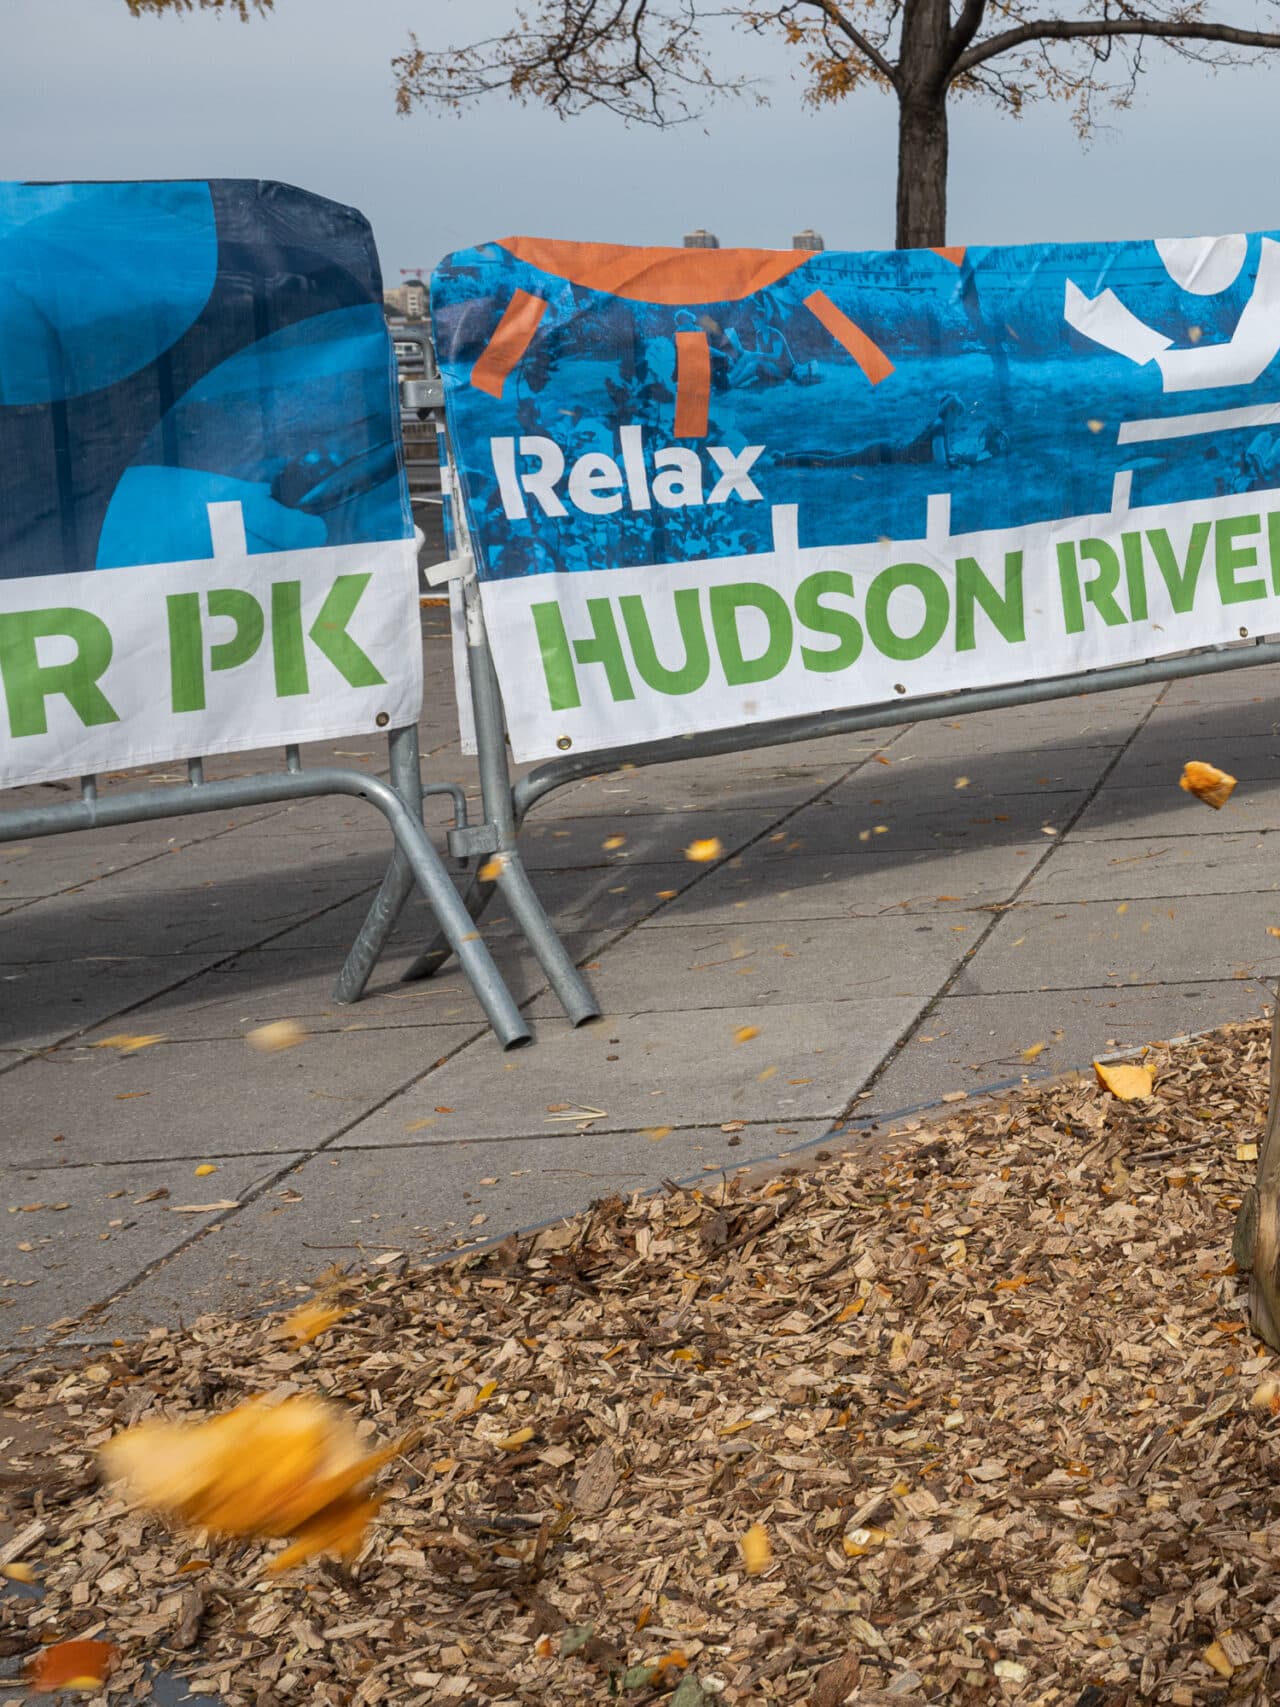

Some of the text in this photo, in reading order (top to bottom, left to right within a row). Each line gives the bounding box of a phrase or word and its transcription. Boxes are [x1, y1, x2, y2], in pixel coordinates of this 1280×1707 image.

[490, 425, 764, 519] Relax
[166, 573, 387, 713] PK
[530, 551, 1026, 711] HUDSON
